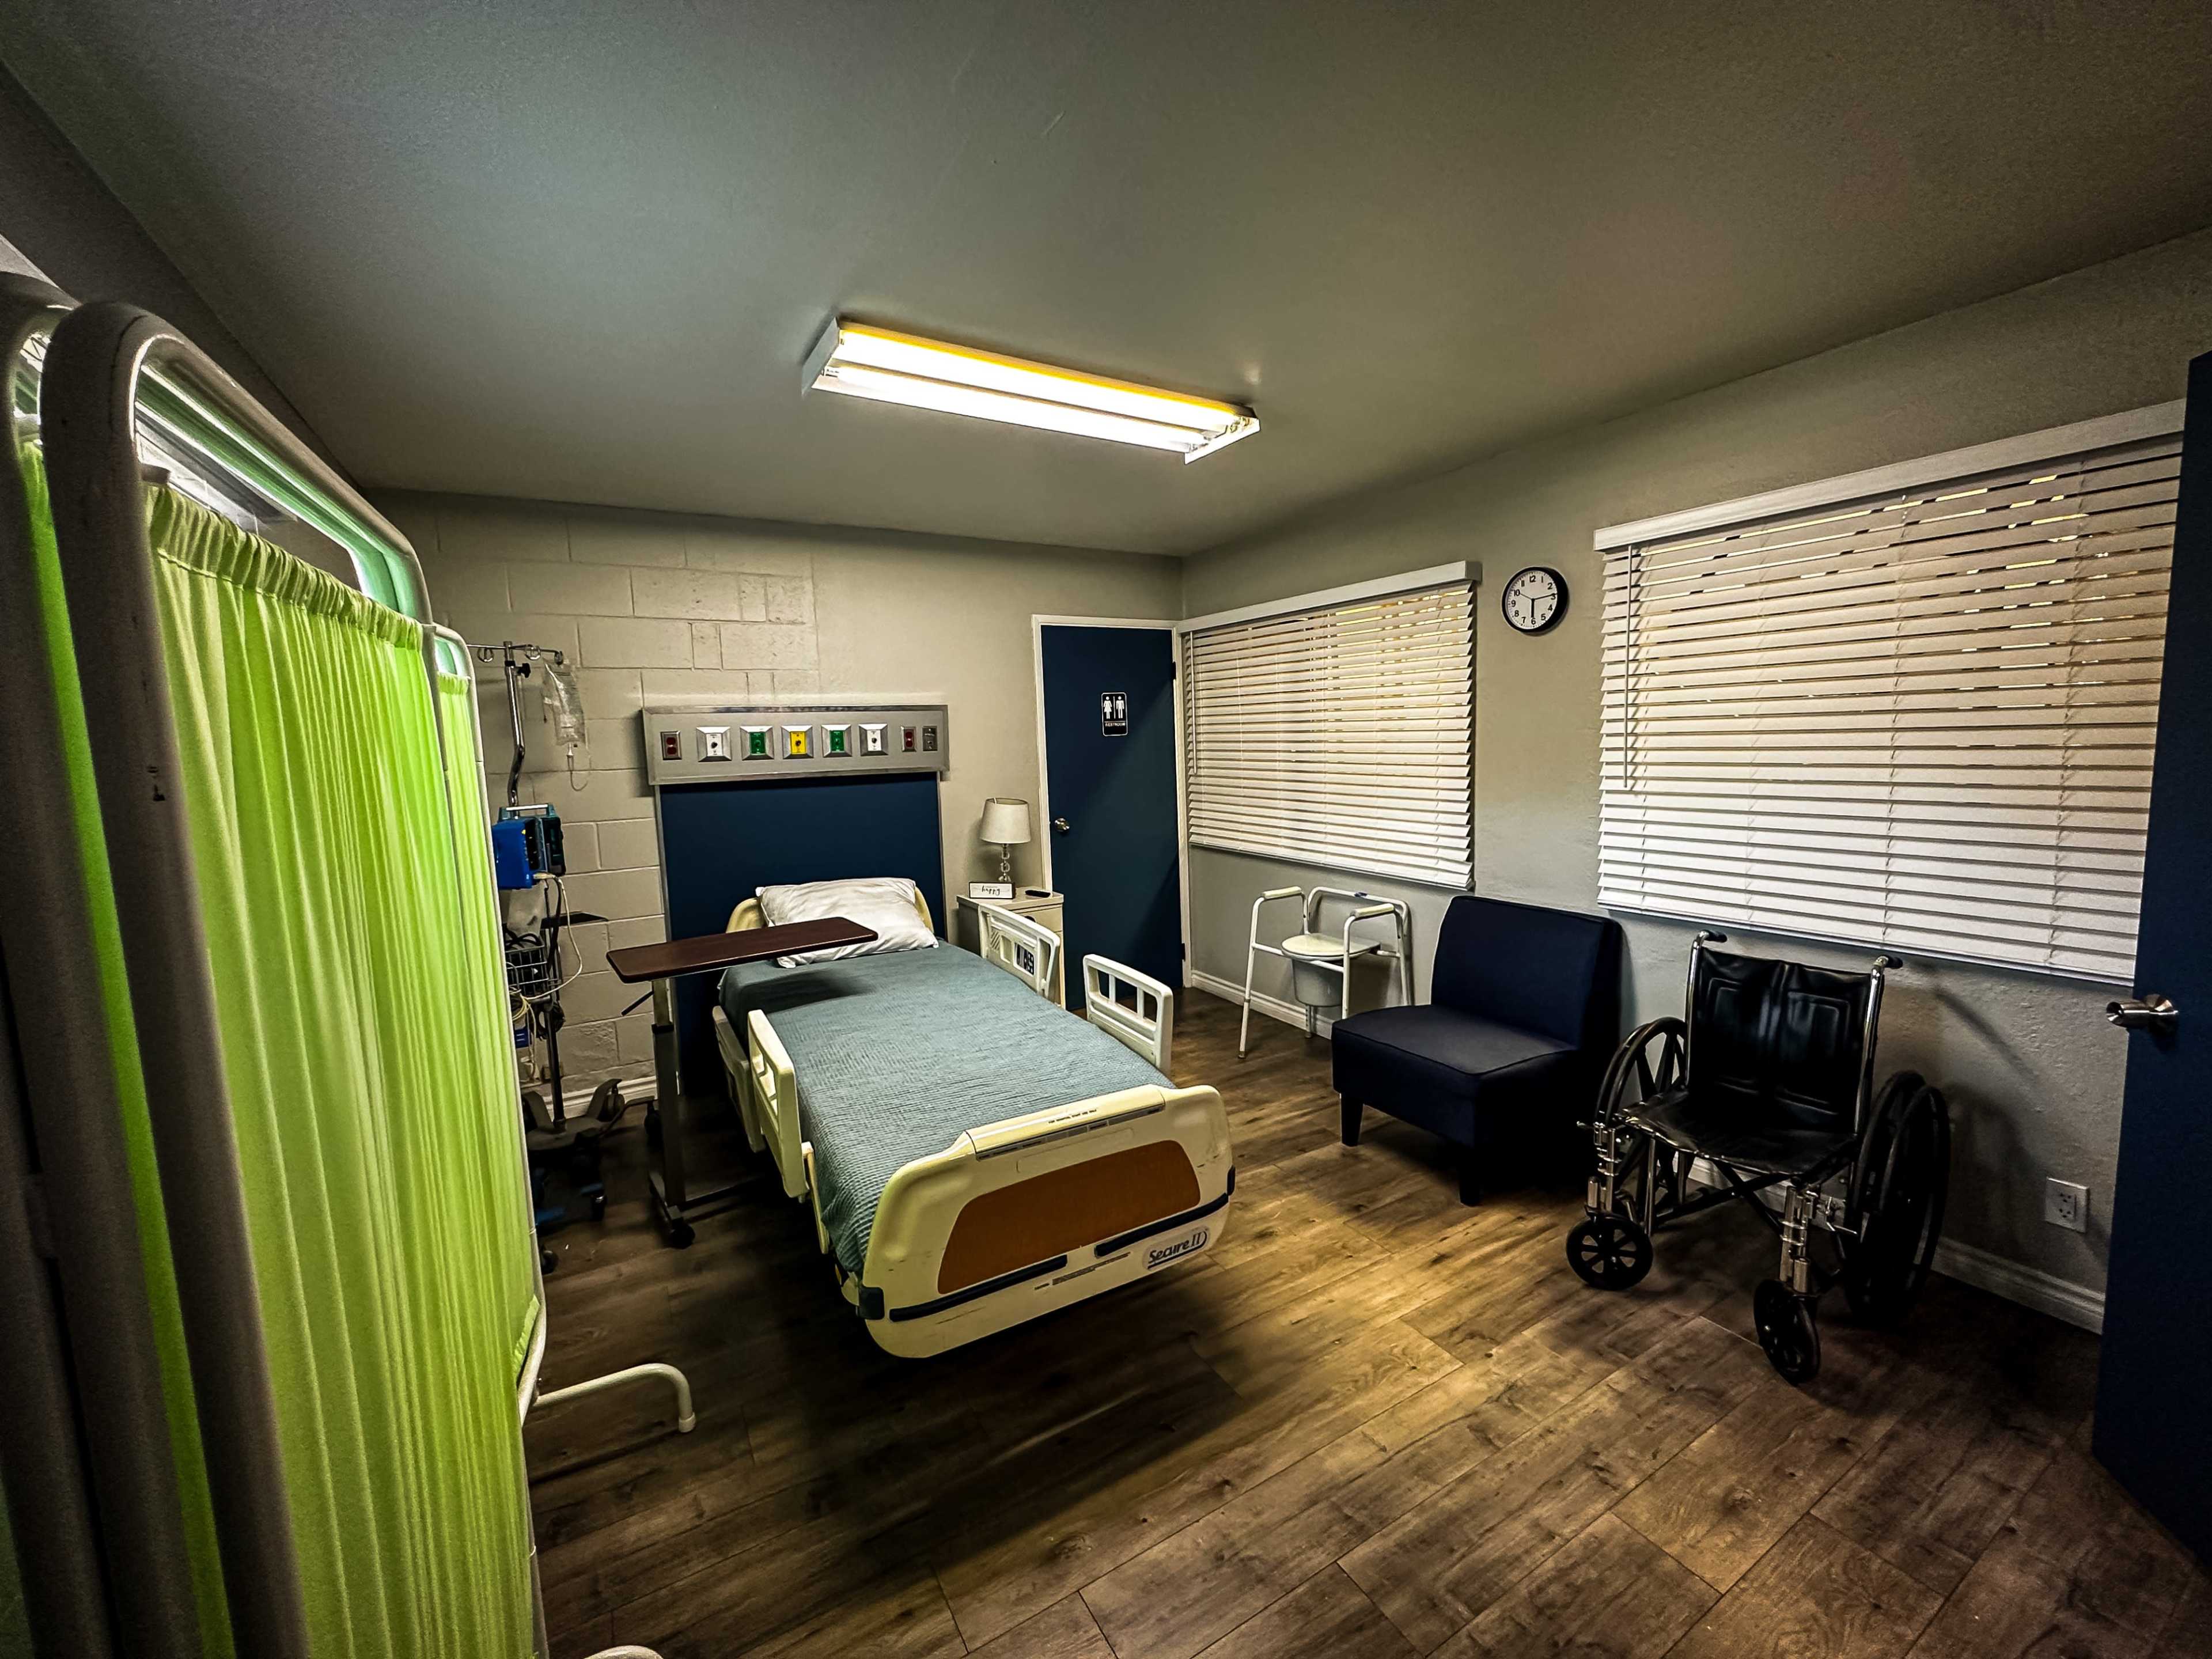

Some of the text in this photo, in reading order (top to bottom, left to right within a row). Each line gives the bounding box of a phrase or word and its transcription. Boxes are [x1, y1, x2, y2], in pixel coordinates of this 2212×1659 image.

[1529, 575, 1536, 583] 12
[1514, 609, 1520, 618] 8
[1148, 1240, 1190, 1264] Secure
